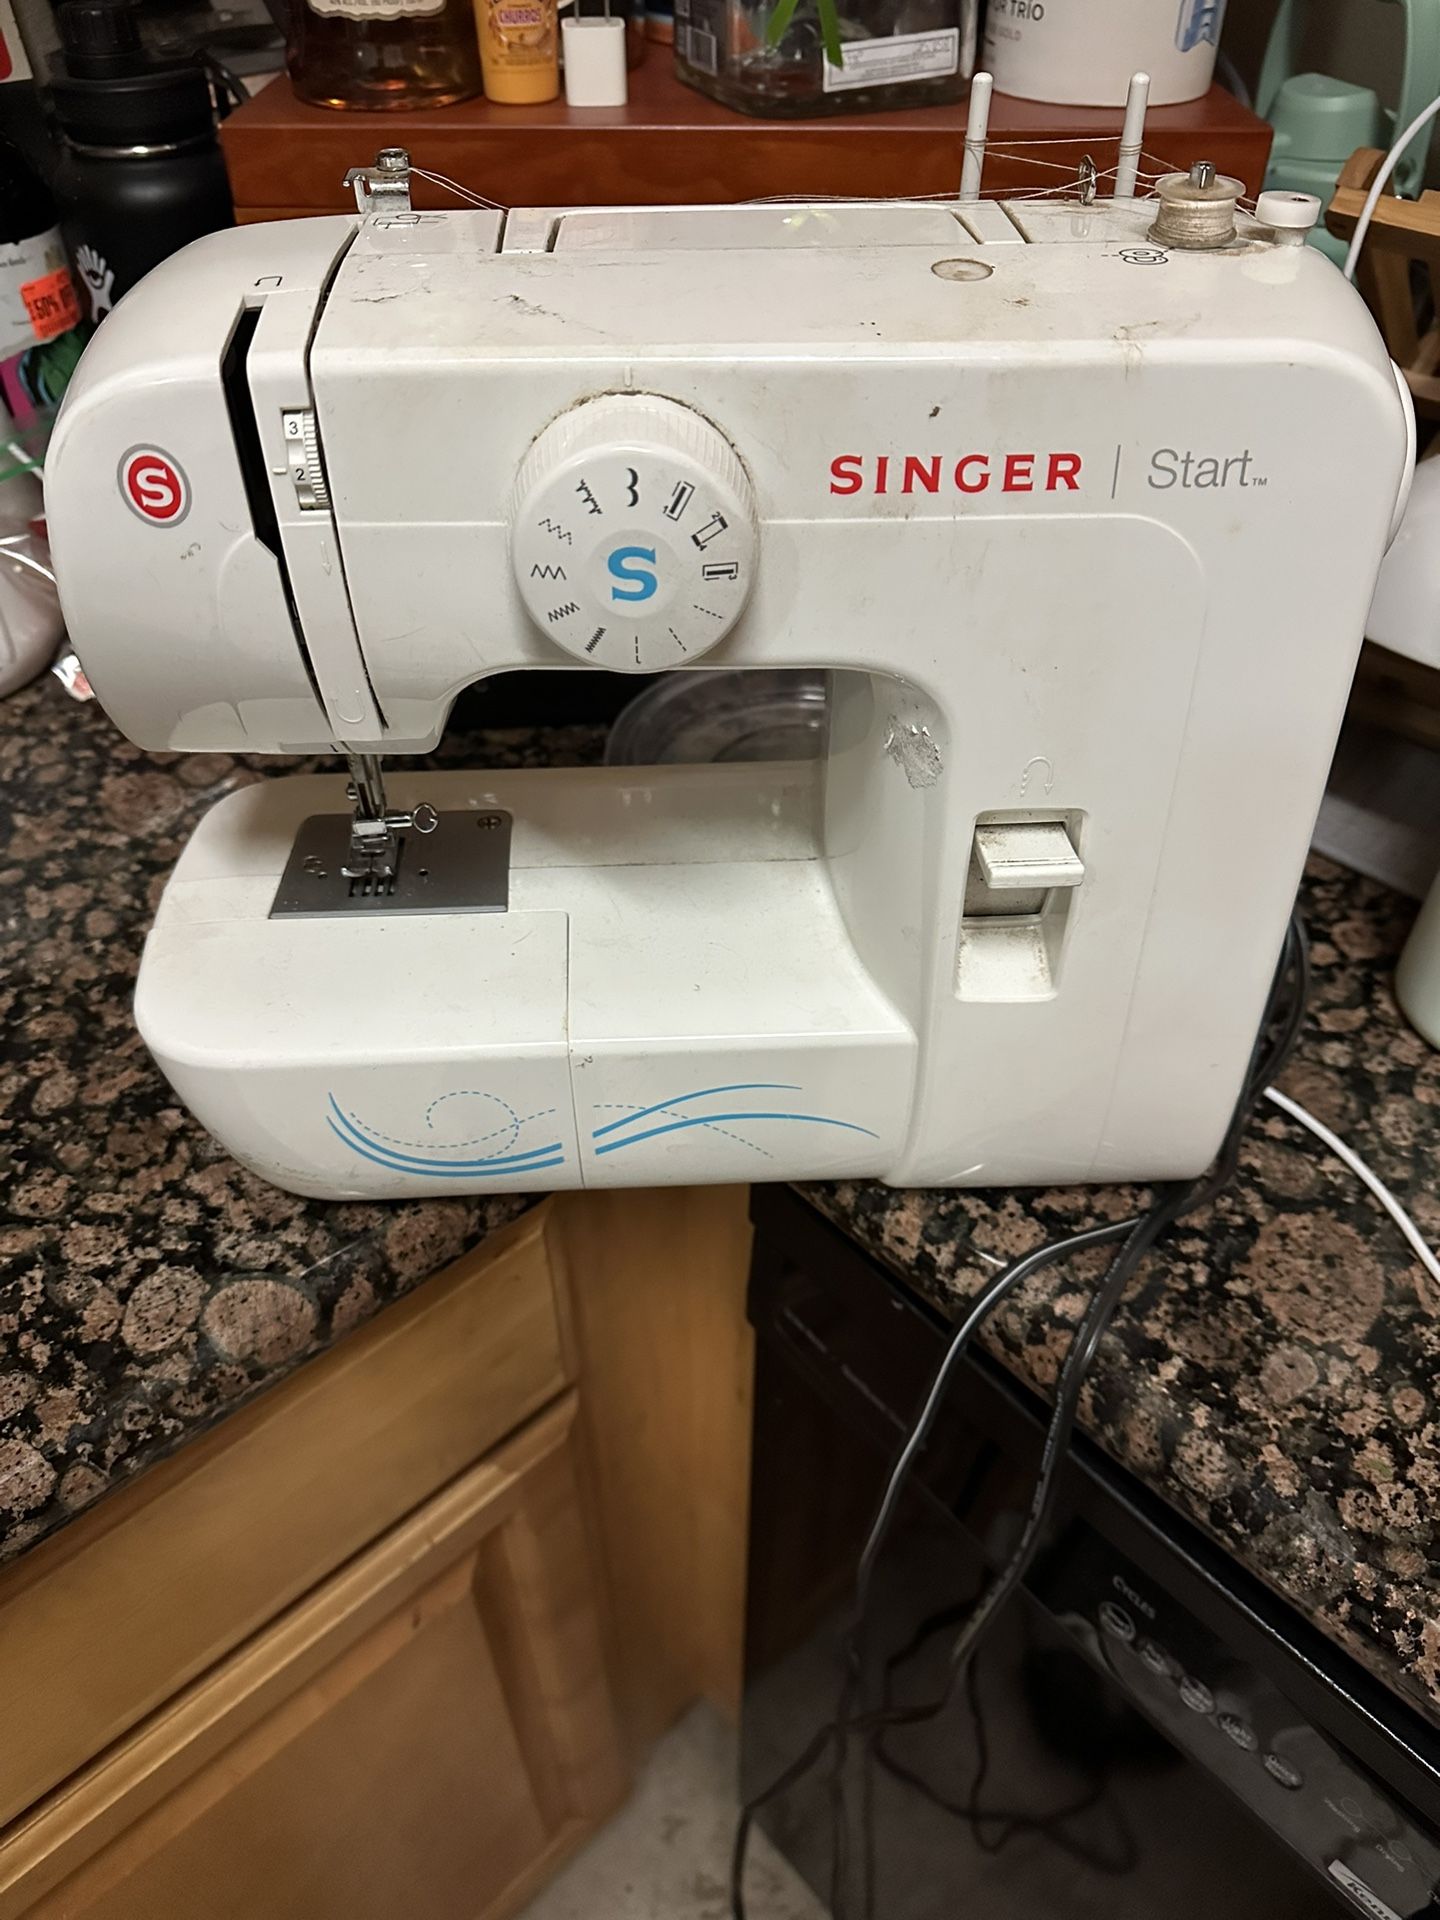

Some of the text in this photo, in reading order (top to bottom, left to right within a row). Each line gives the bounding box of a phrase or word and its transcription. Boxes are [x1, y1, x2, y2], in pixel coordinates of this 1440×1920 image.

[288, 421, 299, 435] 3
[136, 466, 174, 508] S
[295, 467, 306, 481] 2
[829, 453, 1083, 495] SINGER
[607, 546, 658, 602] S
